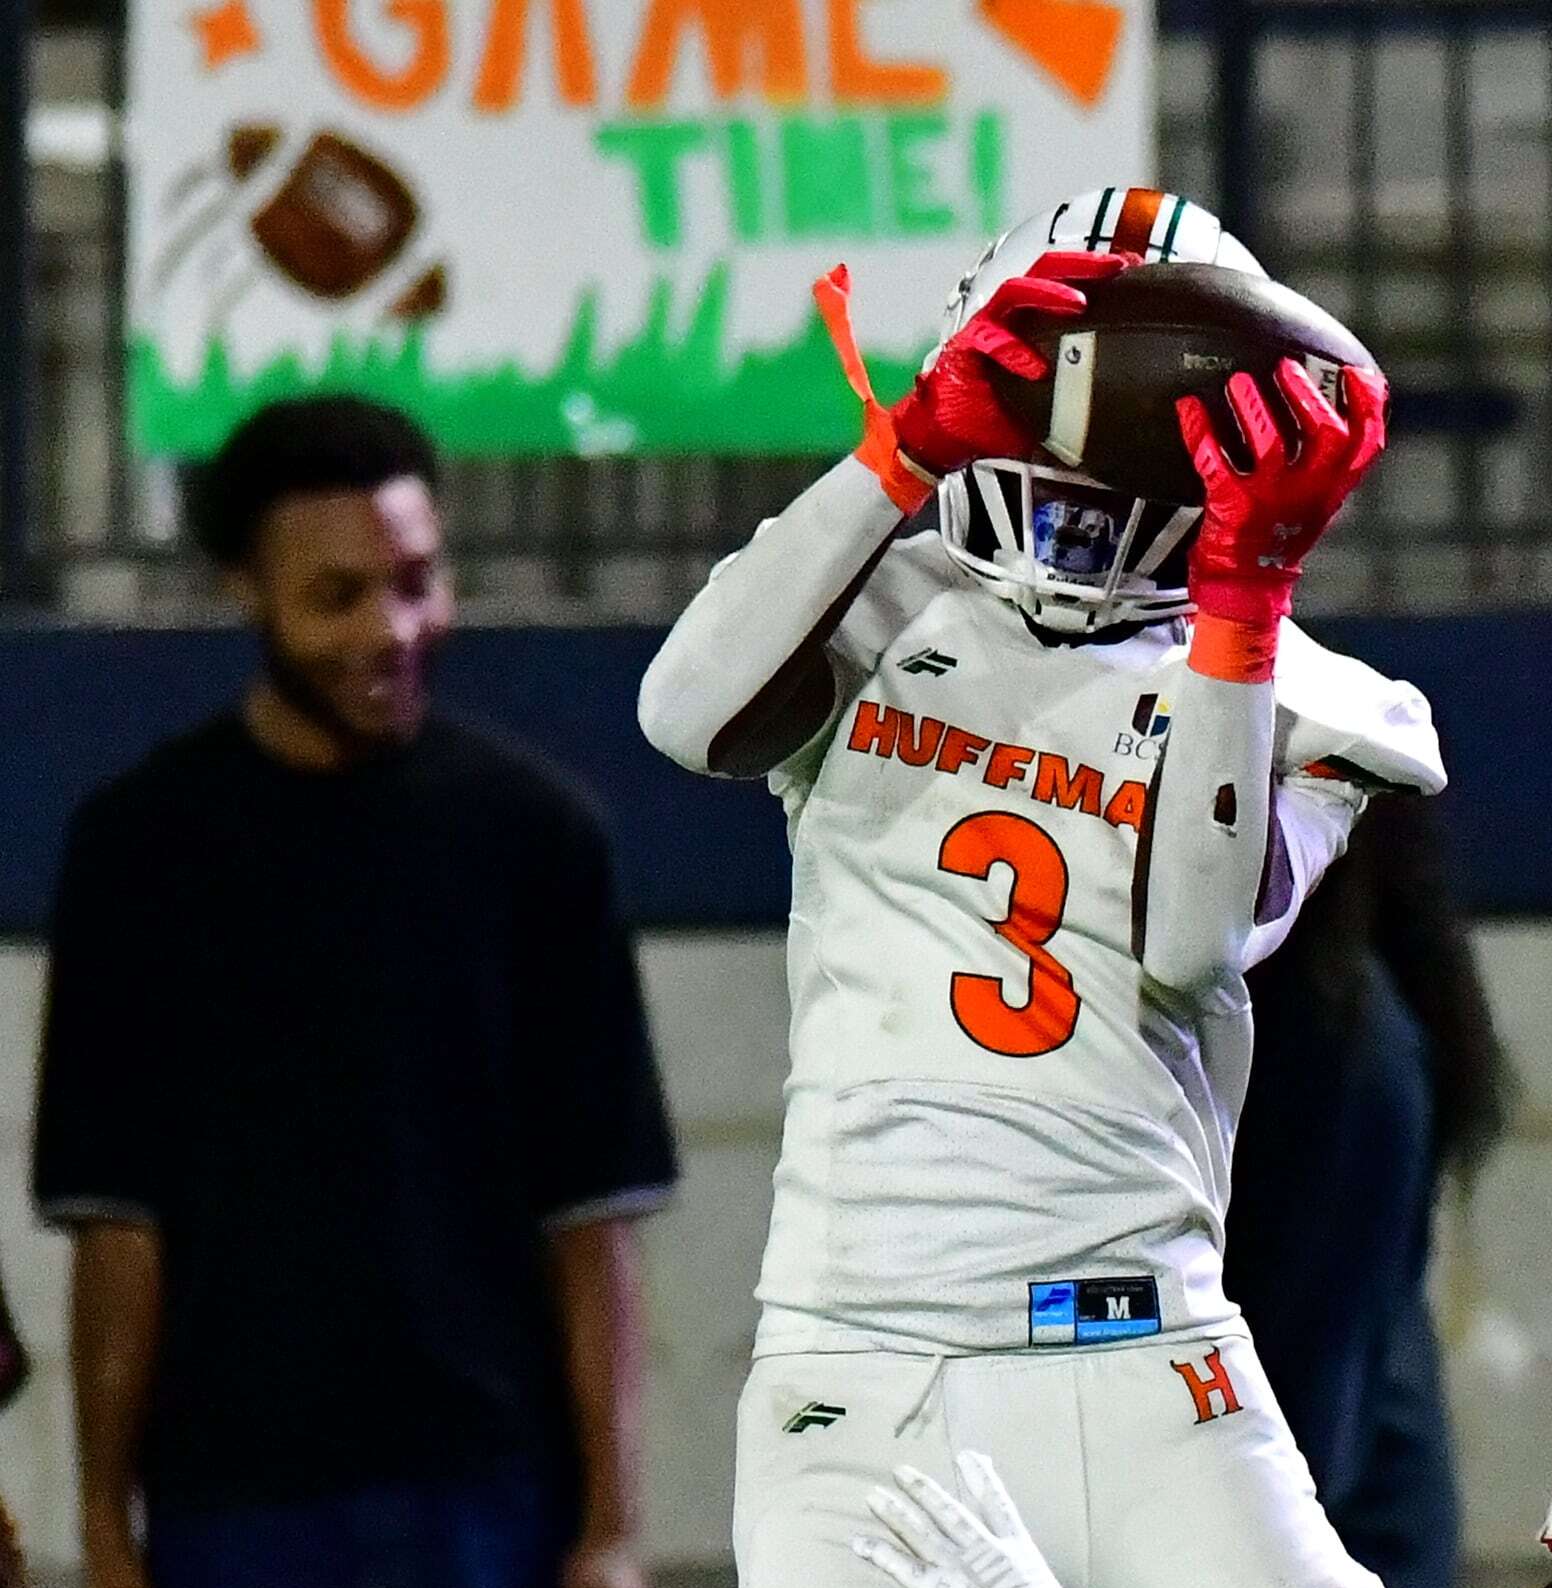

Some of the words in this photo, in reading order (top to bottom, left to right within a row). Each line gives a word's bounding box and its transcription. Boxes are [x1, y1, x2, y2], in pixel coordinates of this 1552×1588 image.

[594, 112, 1008, 248] TIME!
[937, 809, 1081, 1058] 3
[1105, 1295, 1132, 1320] M
[1170, 1345, 1244, 1425] H
